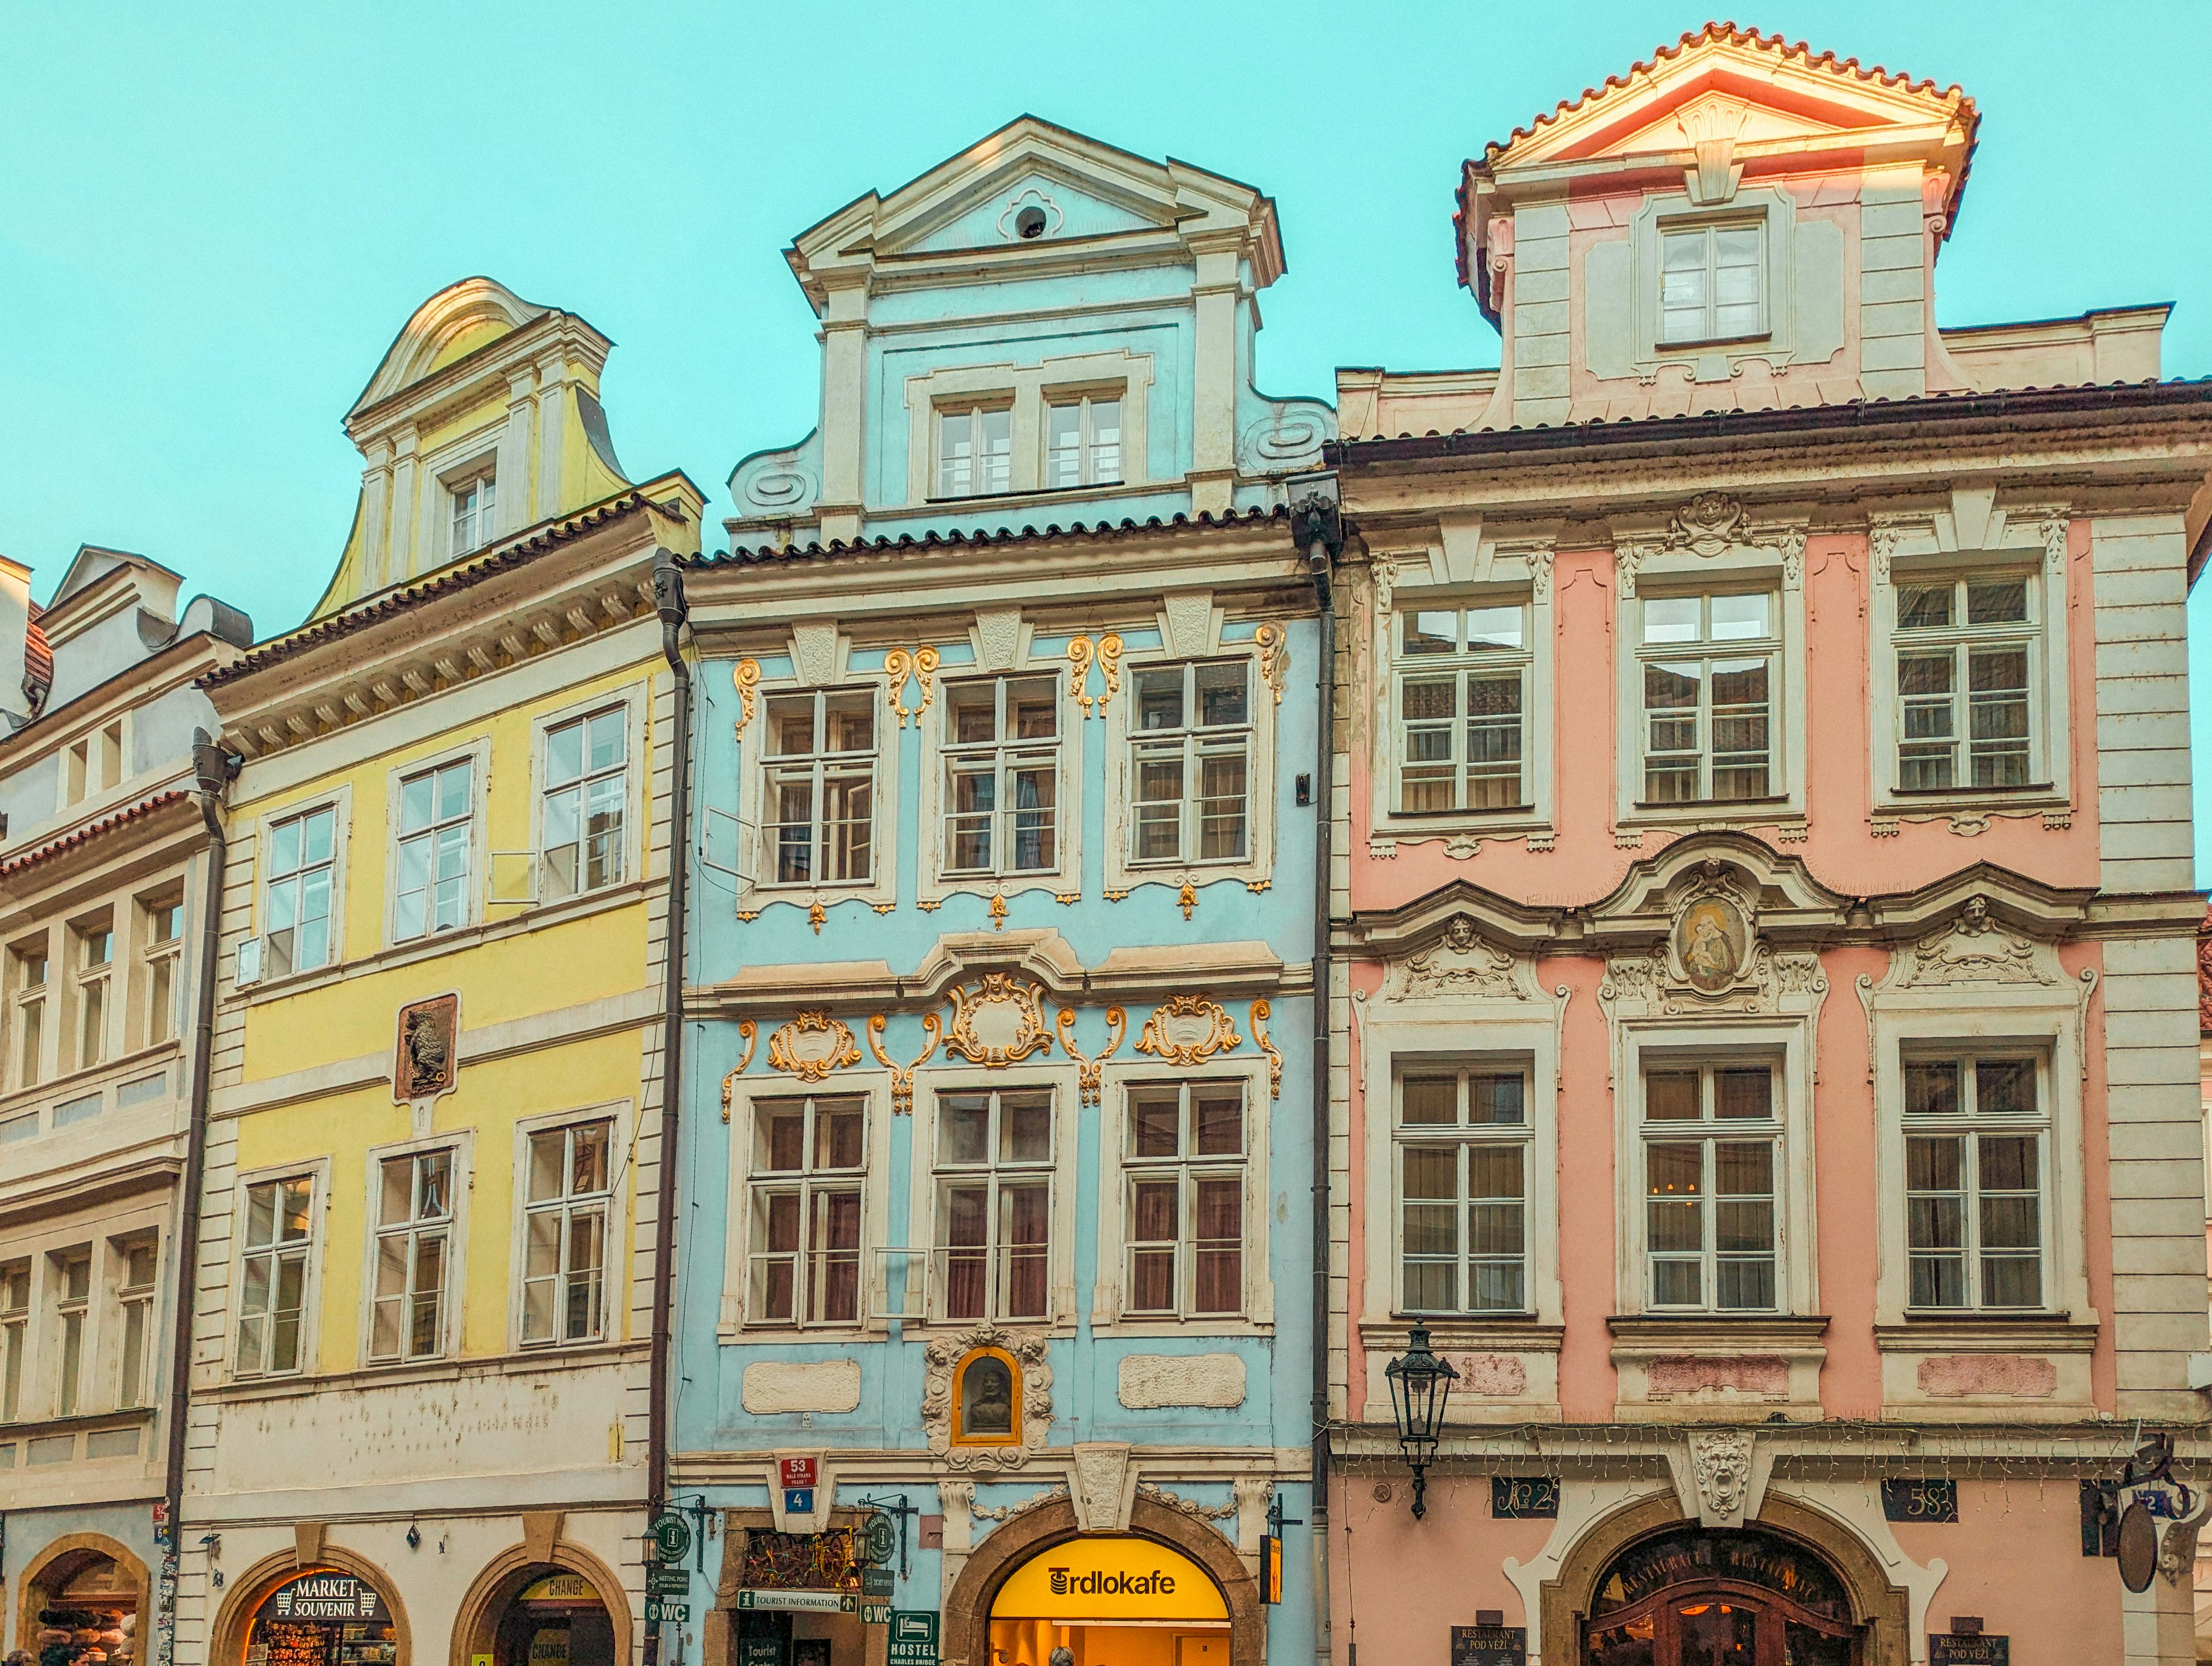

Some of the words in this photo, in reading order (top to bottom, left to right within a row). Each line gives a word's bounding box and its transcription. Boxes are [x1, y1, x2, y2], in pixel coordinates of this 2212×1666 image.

[790, 1460, 806, 1472] 53
[793, 1494, 802, 1507] 4
[2148, 1496, 2156, 1510] 2
[157, 1505, 165, 1515] 52
[654, 1516, 676, 1530] TOURIST
[677, 1519, 687, 1533] INFO
[869, 1516, 884, 1530] TOURIST
[157, 1528, 163, 1539] 6
[296, 1579, 358, 1597] MARKET
[549, 1579, 583, 1595] CHANGE
[1048, 1568, 1175, 1595] Trdlokafe
[789, 1597, 839, 1608] INFORMATION
[295, 1602, 355, 1617] SOUVENIR
[661, 1604, 686, 1621] WC
[874, 1606, 891, 1623] WC
[1462, 1629, 1515, 1639] RESTAURANT
[1470, 1640, 1486, 1650] POD
[1941, 1637, 1997, 1649] RESTAURANT
[748, 1644, 777, 1657] Tourist
[891, 1644, 936, 1656] HOSTEL
[1950, 1649, 1966, 1659] POD
